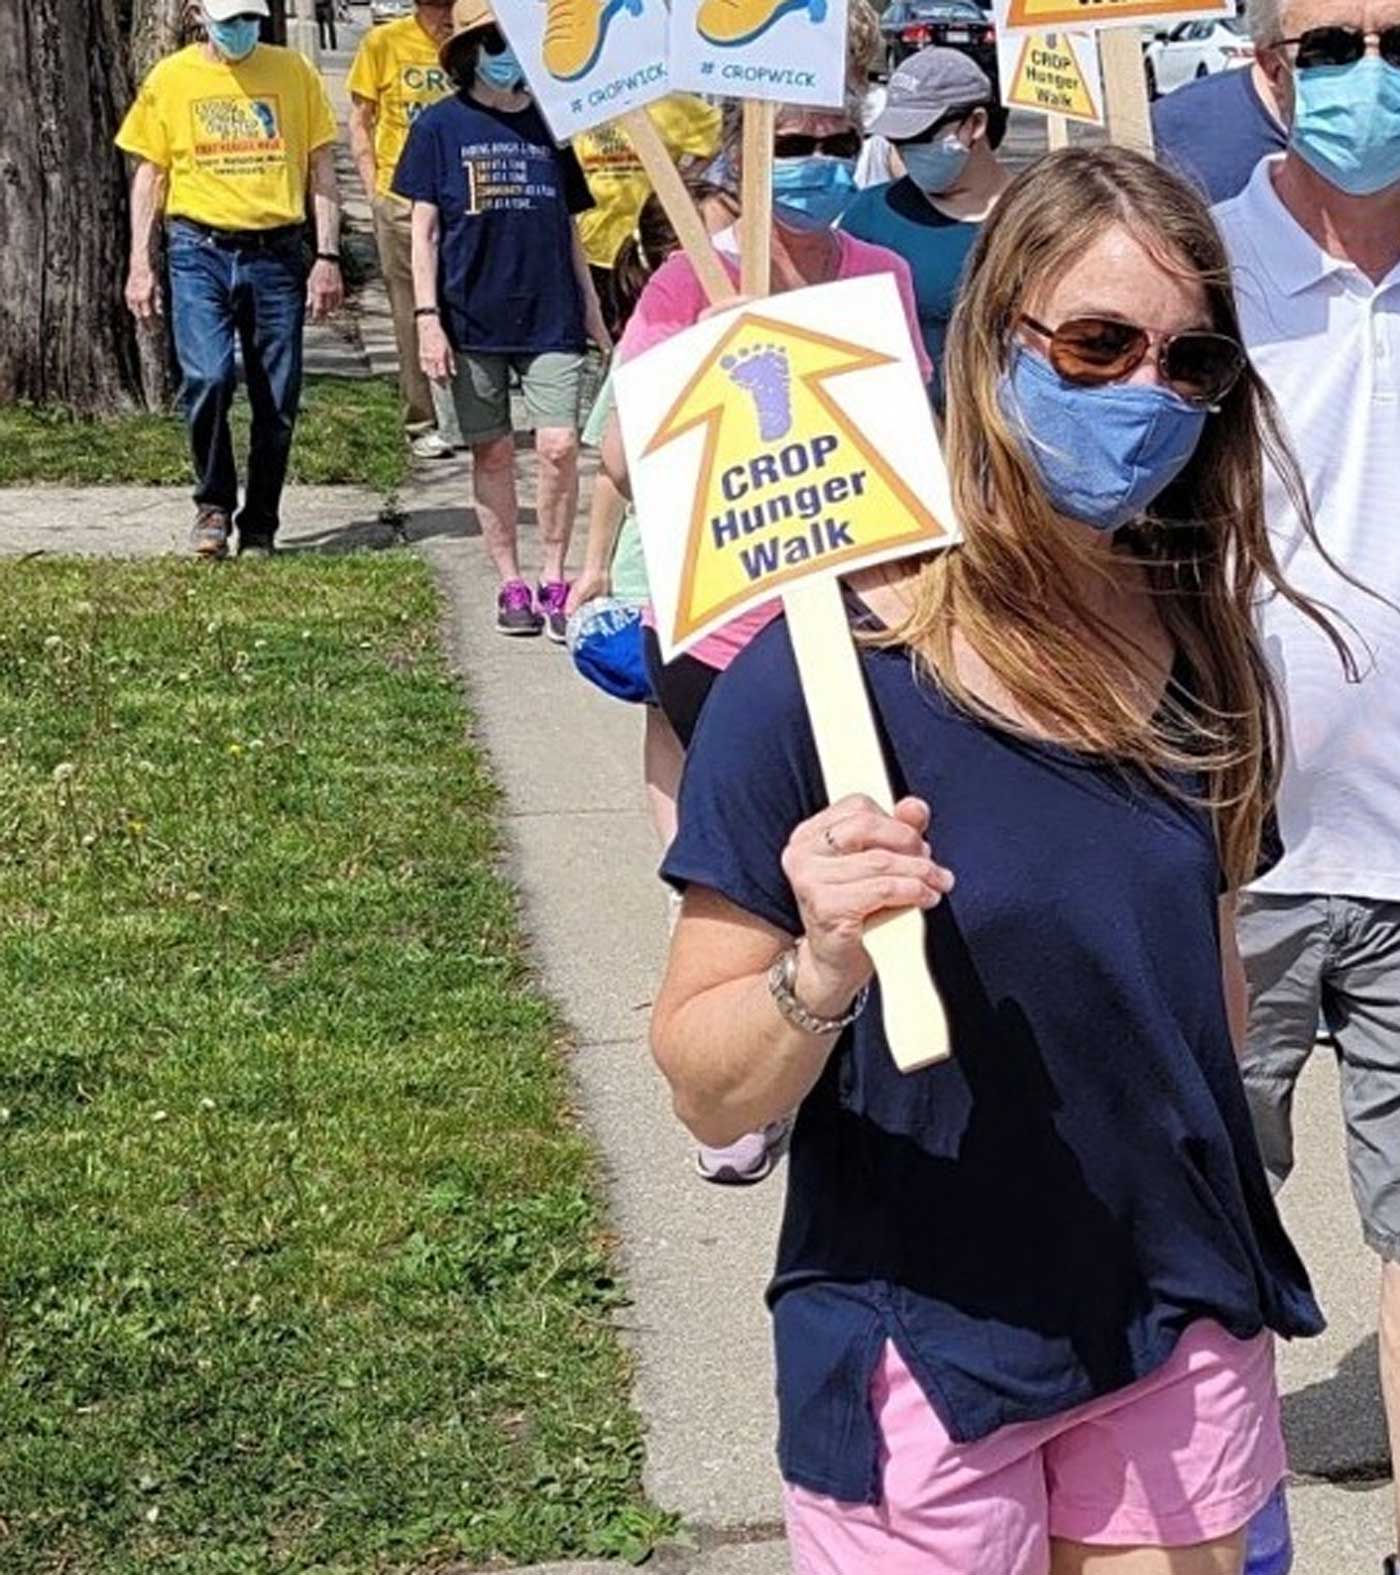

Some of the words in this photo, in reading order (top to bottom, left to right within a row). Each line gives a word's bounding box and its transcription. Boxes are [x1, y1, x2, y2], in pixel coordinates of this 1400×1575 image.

[721, 63, 817, 90] CROPWICK
[1030, 48, 1071, 70] CROP
[587, 61, 668, 107] CROPWICK
[1026, 66, 1078, 91] Hunger
[1034, 86, 1072, 107] Walk
[721, 434, 838, 501] CROP
[711, 470, 867, 549] Hunger
[739, 518, 855, 581] Walk
